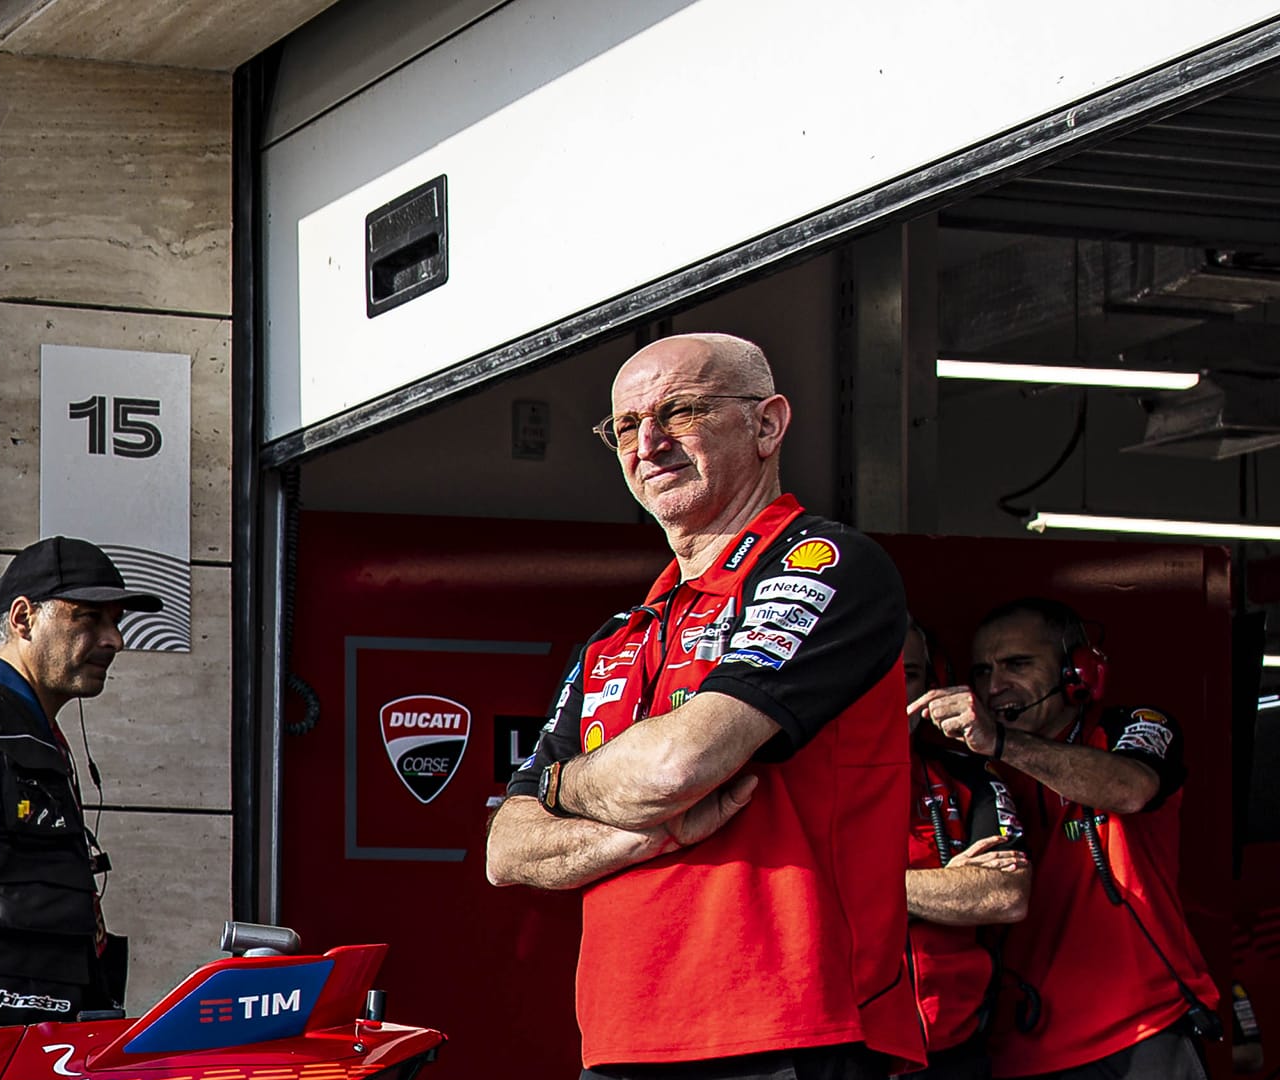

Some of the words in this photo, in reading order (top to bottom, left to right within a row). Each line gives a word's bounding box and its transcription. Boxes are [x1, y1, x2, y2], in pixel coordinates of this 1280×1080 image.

[68, 395, 162, 459] 15
[726, 535, 755, 570] Lenovo
[772, 582, 826, 602] NetApp
[389, 710, 463, 730] DUCATI
[403, 755, 450, 774] CORSE
[238, 989, 301, 1020] TIM
